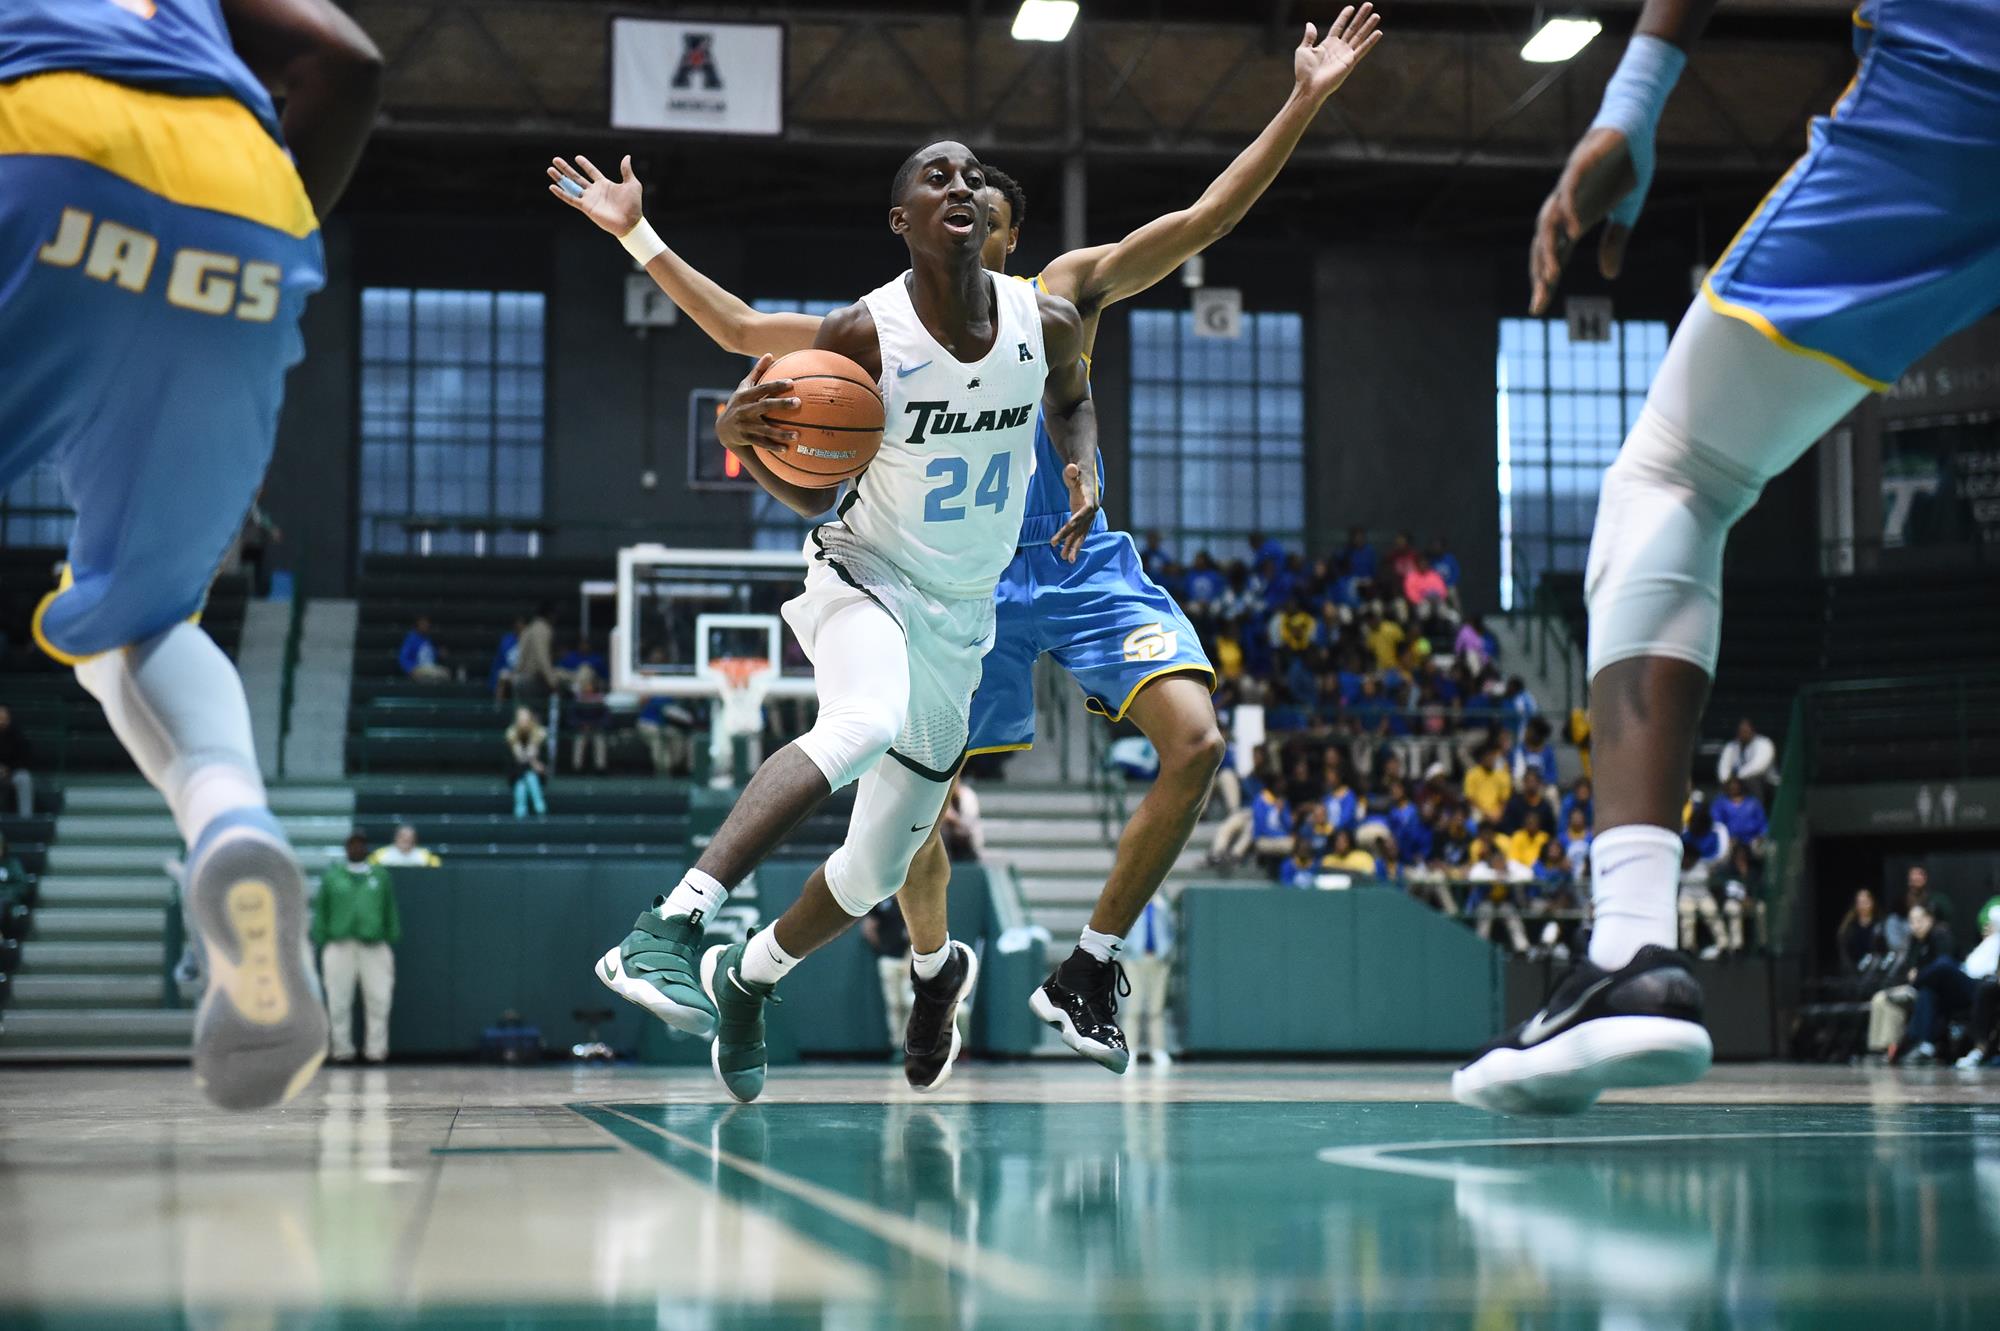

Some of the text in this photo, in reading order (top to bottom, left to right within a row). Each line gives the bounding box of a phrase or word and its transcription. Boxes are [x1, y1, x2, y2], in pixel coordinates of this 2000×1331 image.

[38, 206, 282, 322] JAGS
[1204, 304, 1229, 333] G
[904, 400, 1033, 445] TULANE
[923, 451, 1011, 523] 24
